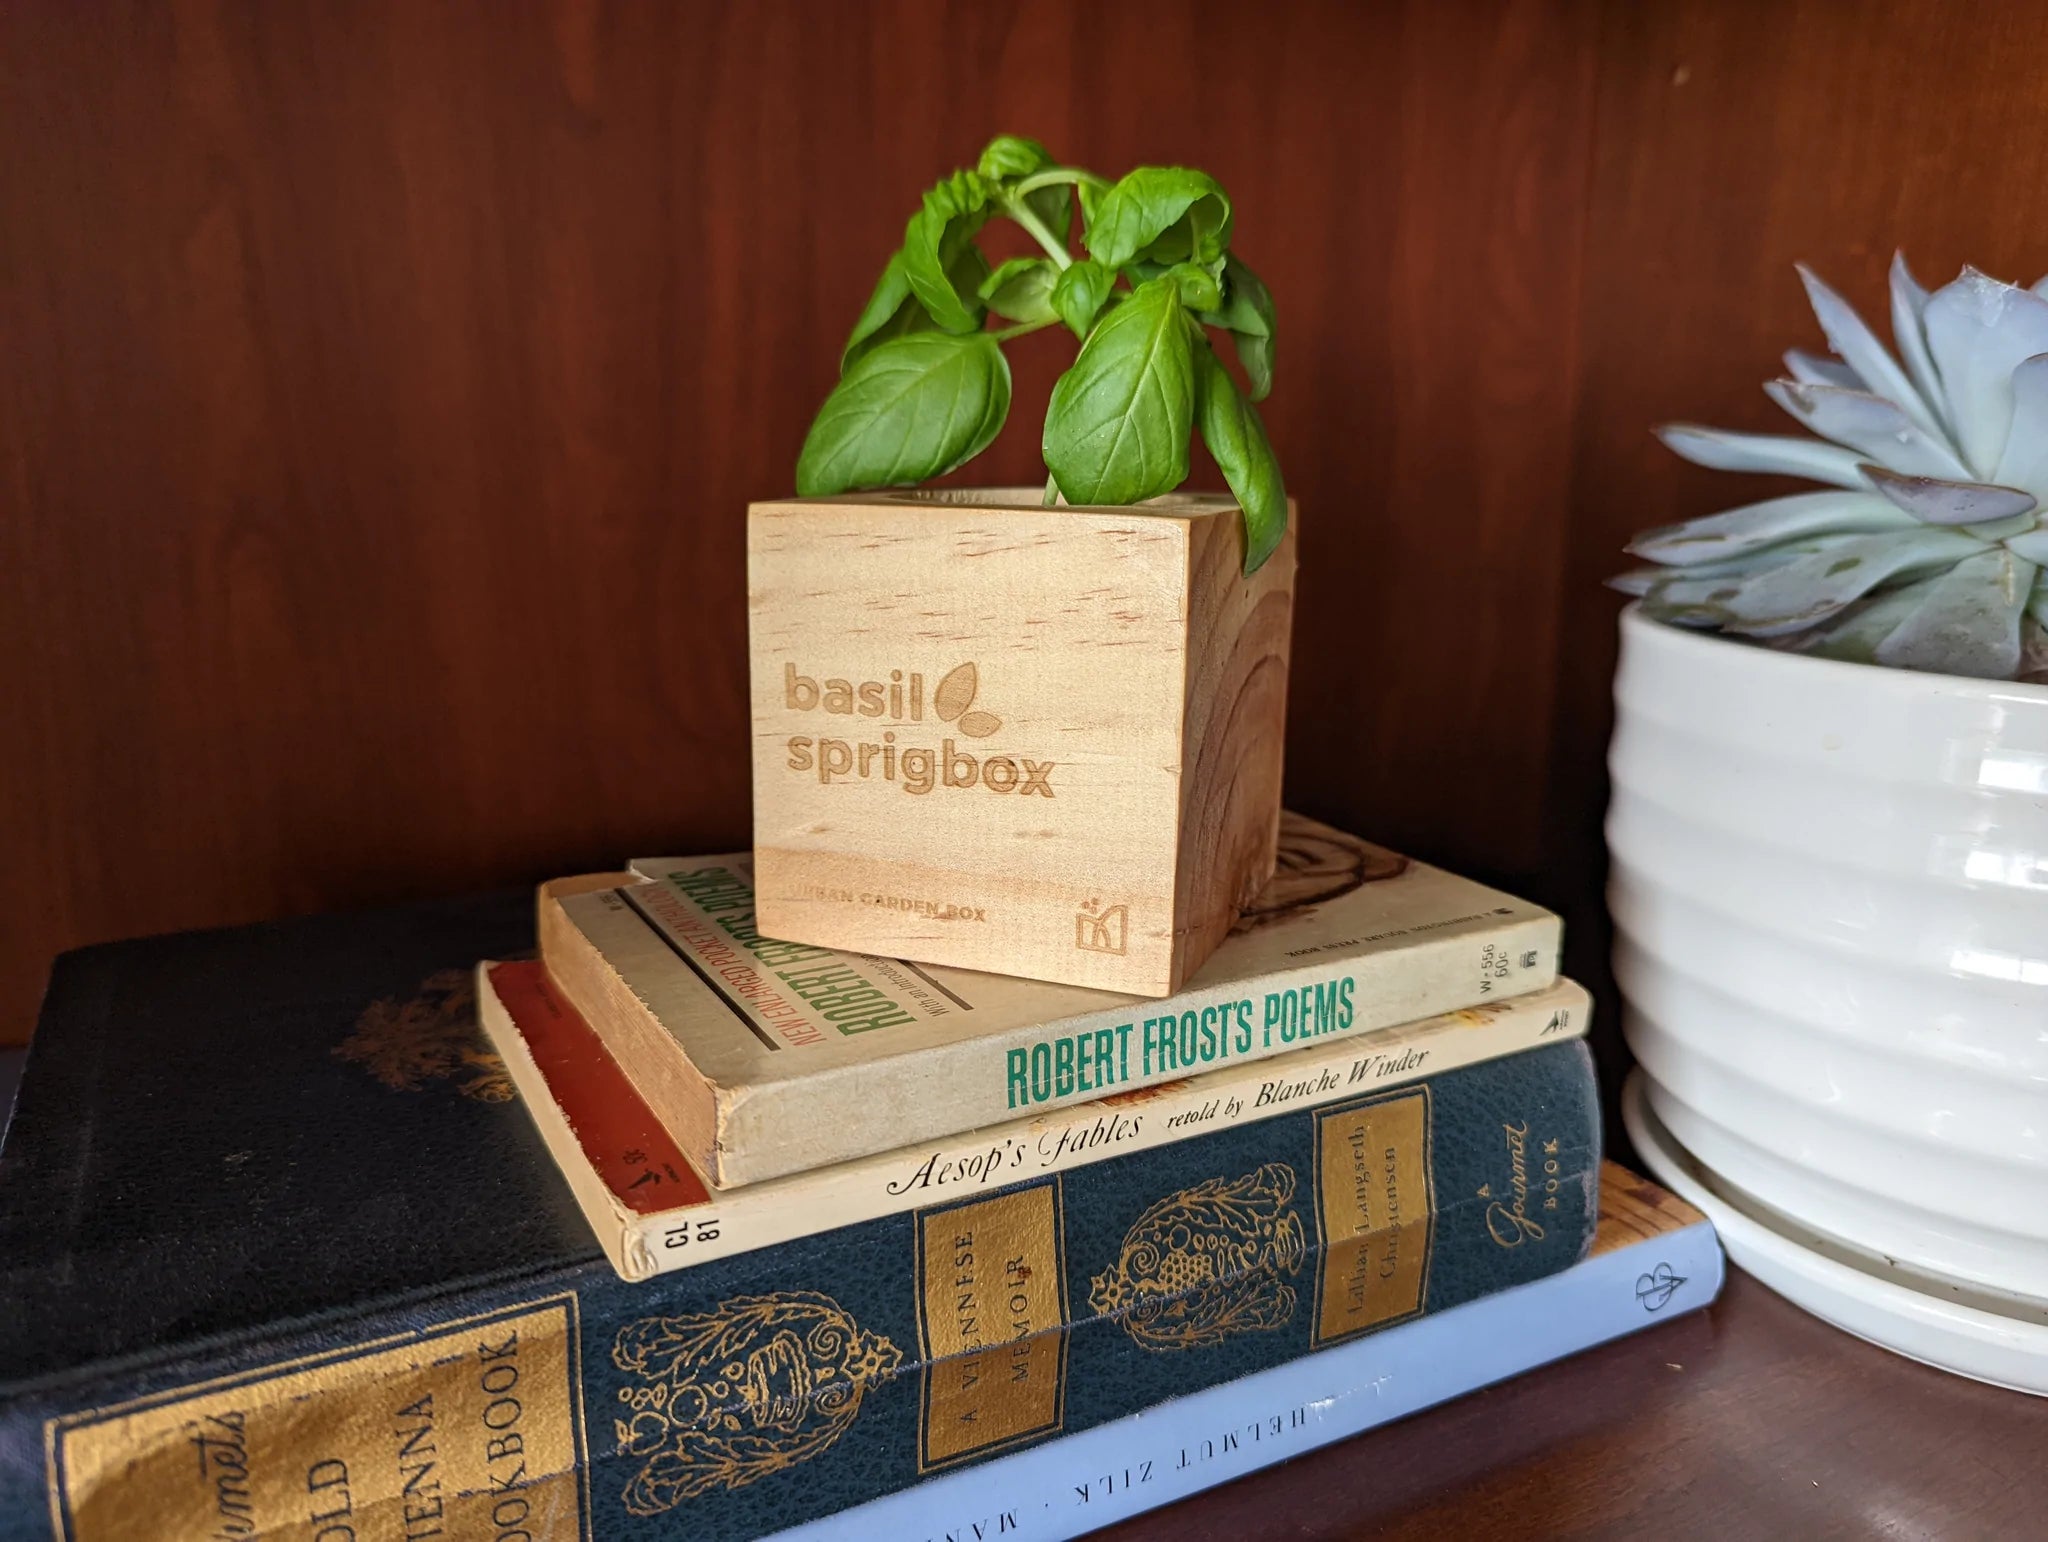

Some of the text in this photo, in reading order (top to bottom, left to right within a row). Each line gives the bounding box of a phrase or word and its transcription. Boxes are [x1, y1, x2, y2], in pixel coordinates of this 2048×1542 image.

[784, 662, 923, 721] basil
[786, 731, 1056, 798] sprigbox
[668, 866, 755, 913] POEMS
[946, 904, 986, 922] BOX
[684, 931, 742, 967] POCKET
[719, 965, 798, 1019] ENLARGED
[774, 962, 918, 1036] ROBERT
[910, 988, 929, 999] an
[918, 999, 950, 1017] With
[772, 1017, 828, 1046] NEW
[1007, 976, 1355, 1109] ROBERT FROST'S POEMS
[886, 1048, 1430, 1195] Aesop's Fables retold by Blanche Winder
[1347, 1125, 1371, 1234] Langseth
[1477, 1182, 1490, 1198] A
[1486, 1119, 1545, 1247] Gourmet
[1543, 1137, 1559, 1209] BOOK
[665, 1221, 689, 1249] CL
[697, 1219, 720, 1242] 81
[955, 1231, 983, 1421] A VIENNESE
[1006, 1255, 1031, 1383] MEMOIR
[395, 1394, 443, 1542] IENNA
[926, 1407, 1305, 1542] HELMUT ZILK MAN
